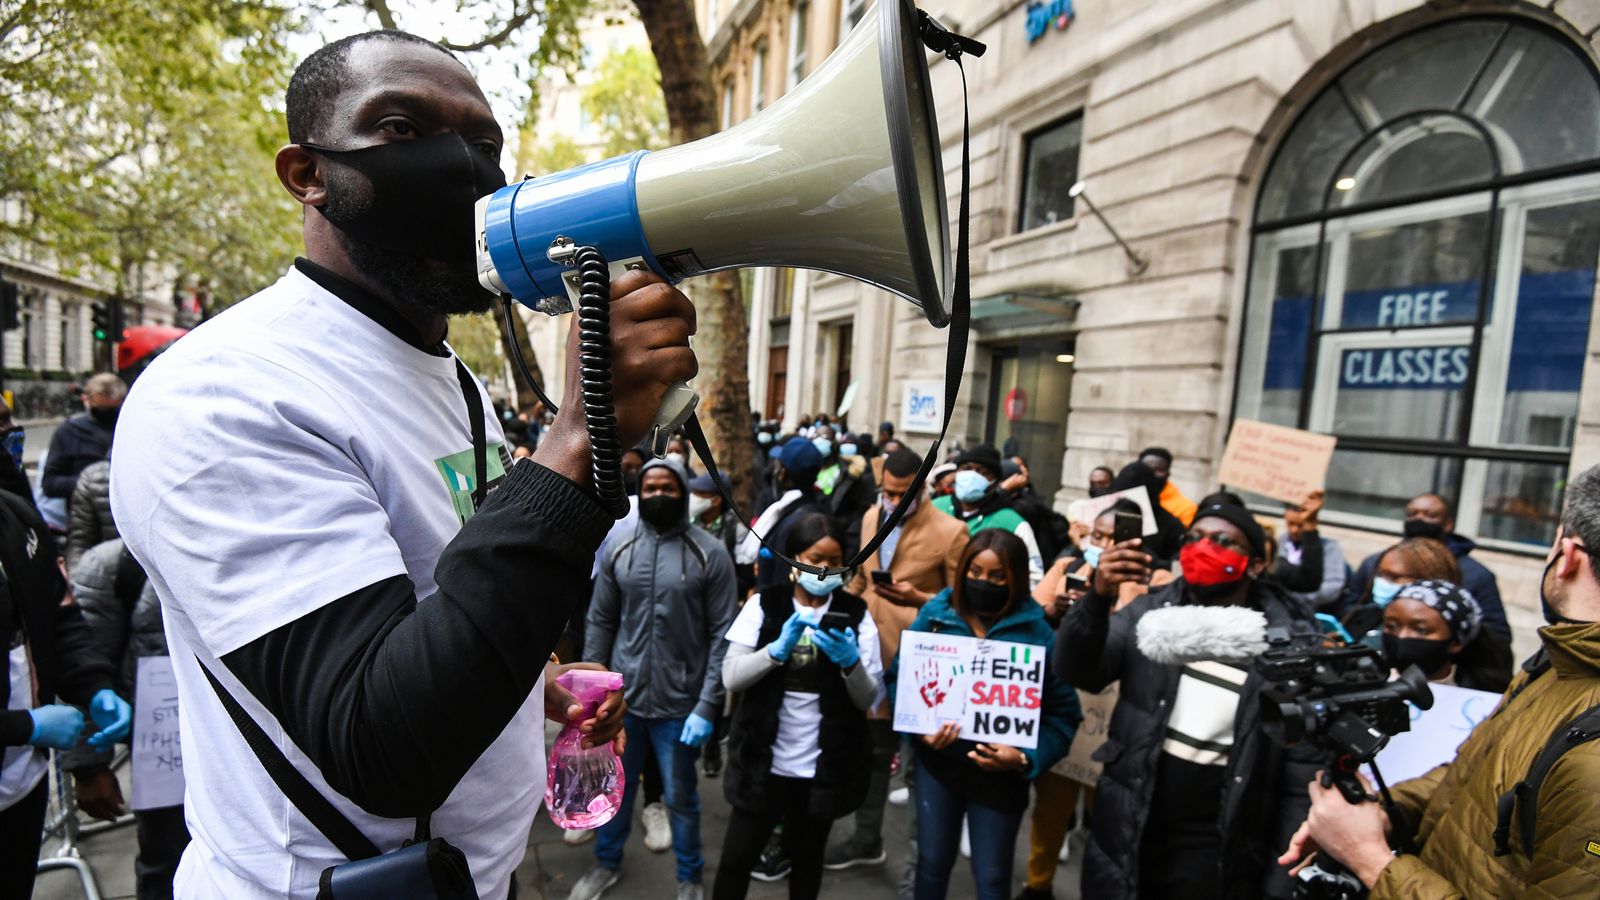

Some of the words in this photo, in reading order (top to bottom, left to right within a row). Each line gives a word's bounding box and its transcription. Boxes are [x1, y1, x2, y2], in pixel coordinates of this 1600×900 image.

[1377, 290, 1448, 328] FREE
[1344, 347, 1470, 383] CLASSES
[910, 395, 935, 415] gym
[970, 656, 1041, 683] #End
[970, 680, 1041, 710] SARS
[973, 711, 1035, 736] NOW
